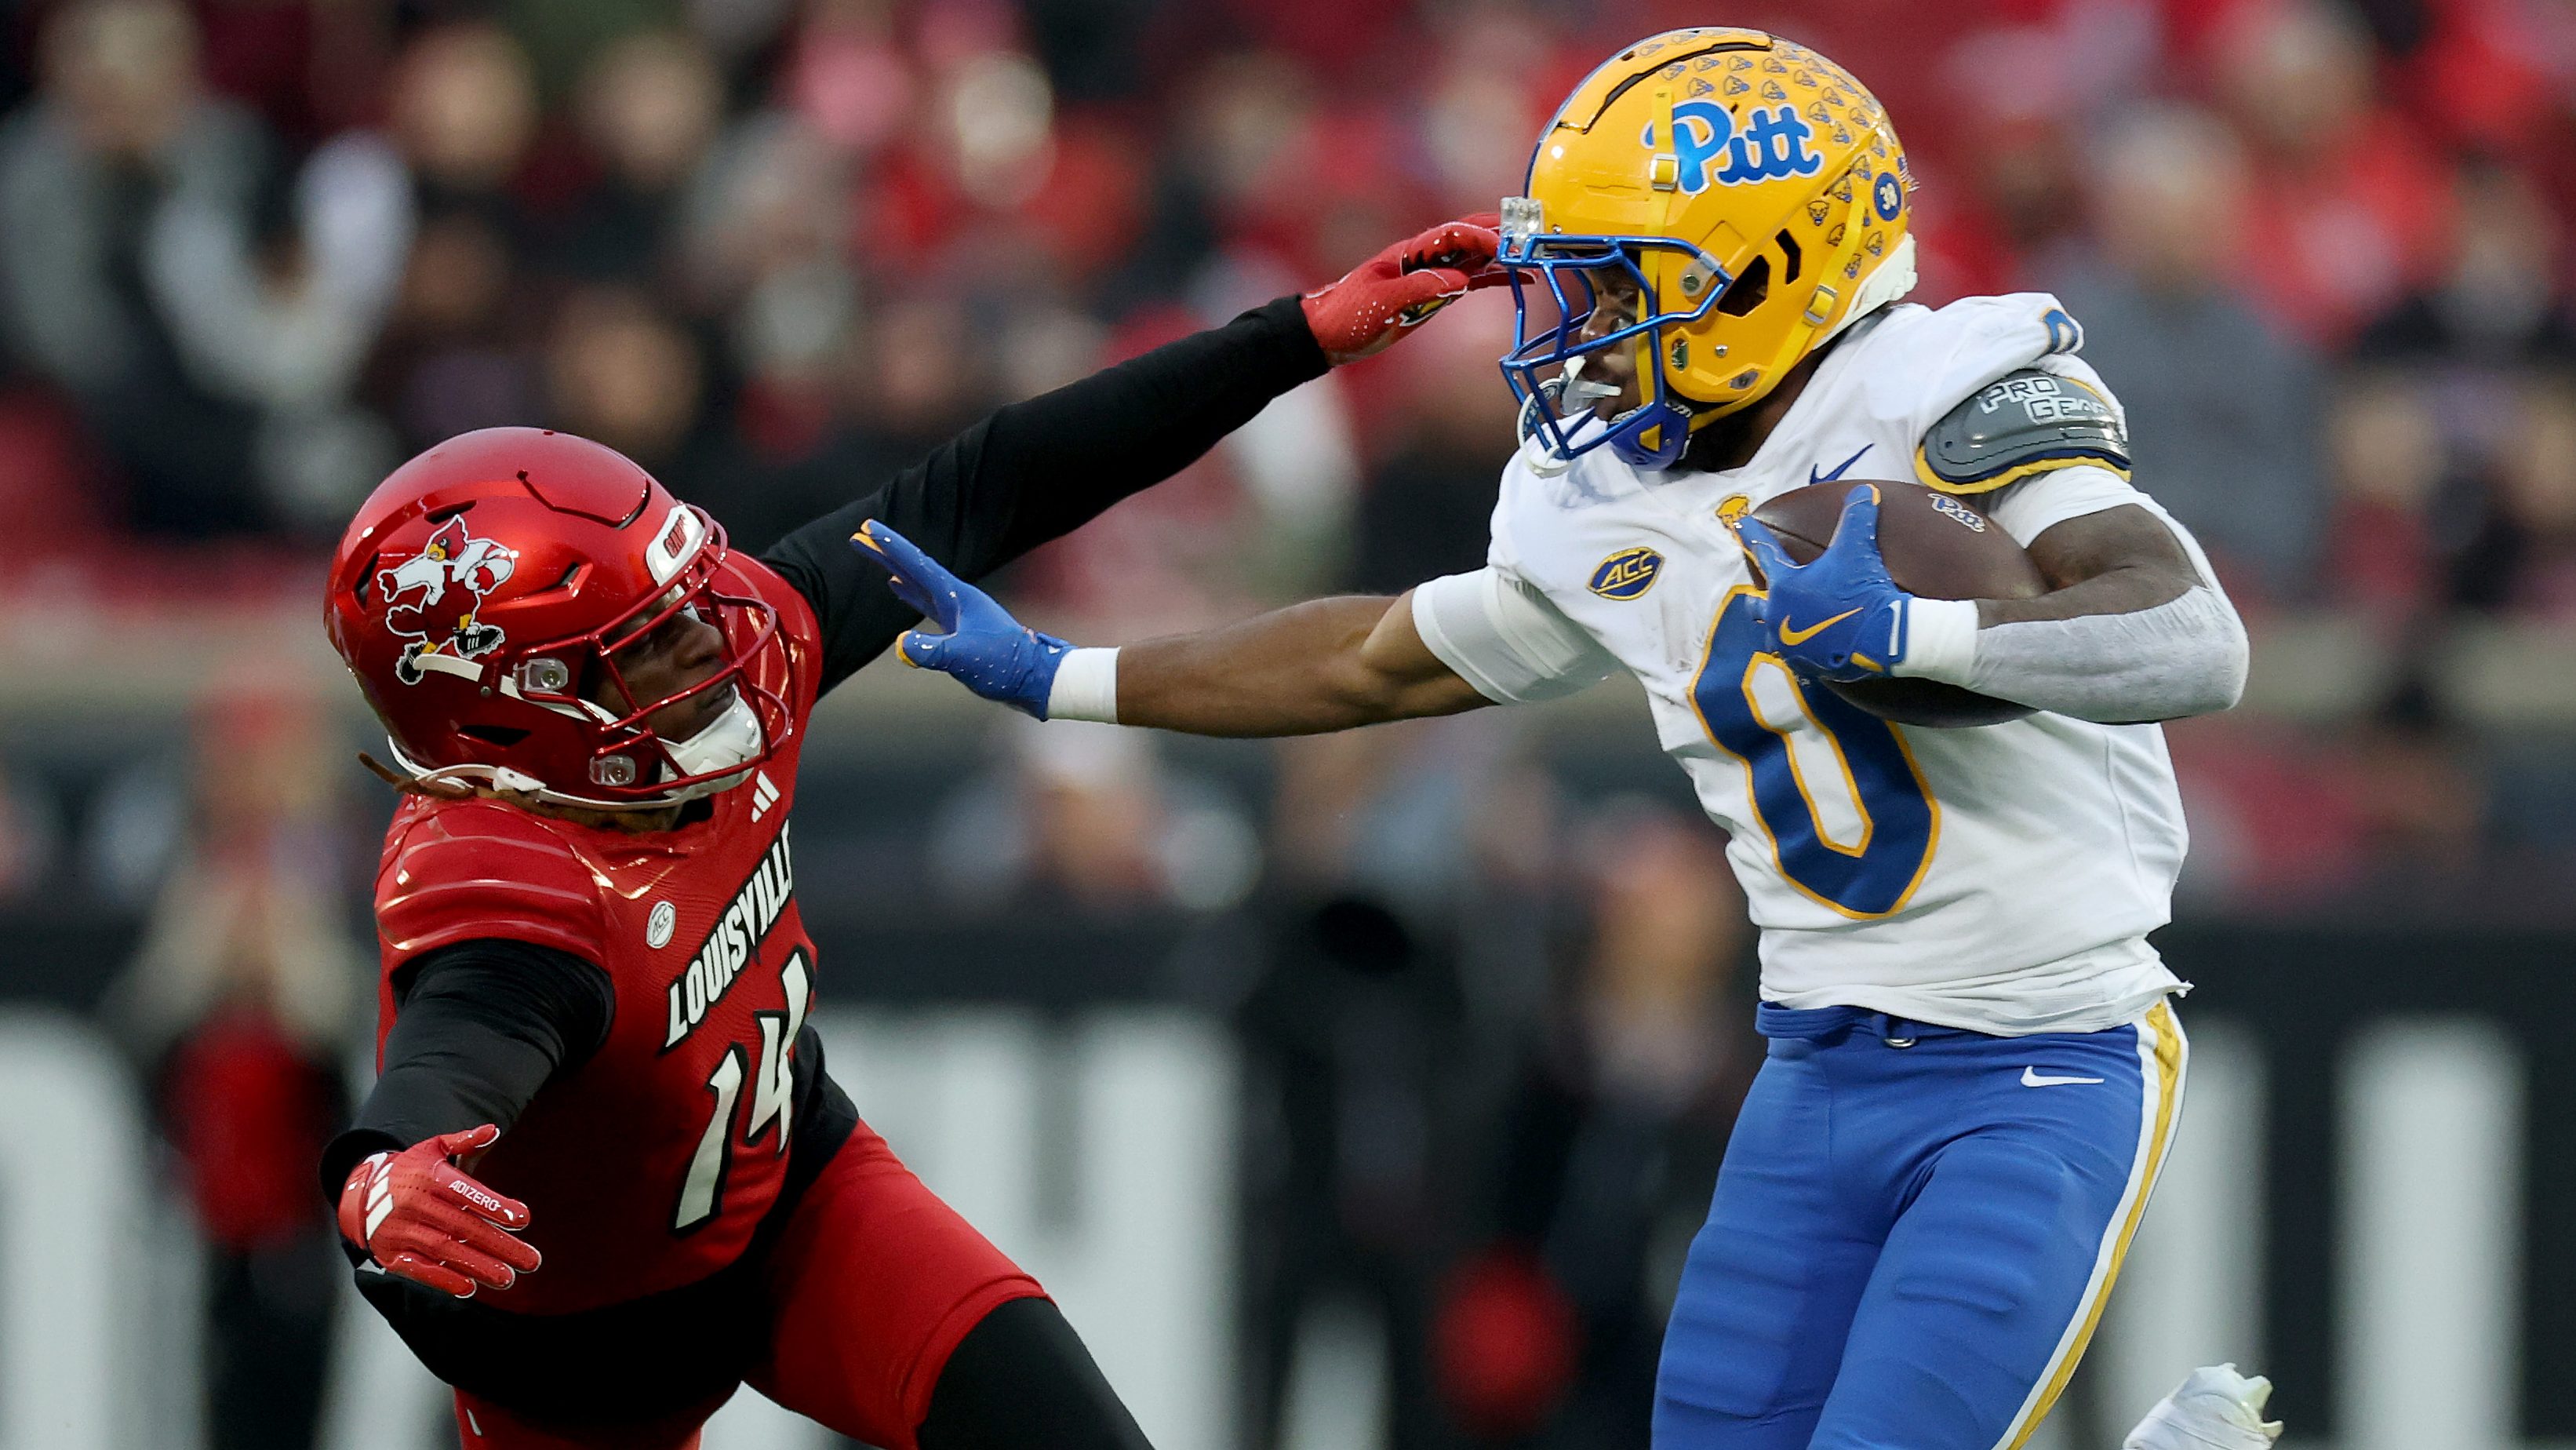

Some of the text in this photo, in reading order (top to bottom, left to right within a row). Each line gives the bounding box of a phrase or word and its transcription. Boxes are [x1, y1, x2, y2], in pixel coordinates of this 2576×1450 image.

[1642, 100, 1824, 195] Pitt
[1976, 377, 2061, 415] PRO
[1927, 493, 1987, 533] Pitt
[1599, 551, 1654, 588] ACC
[1688, 585, 1941, 920] 0
[674, 952, 809, 1230] 14
[449, 1179, 501, 1211] ADIZERO
